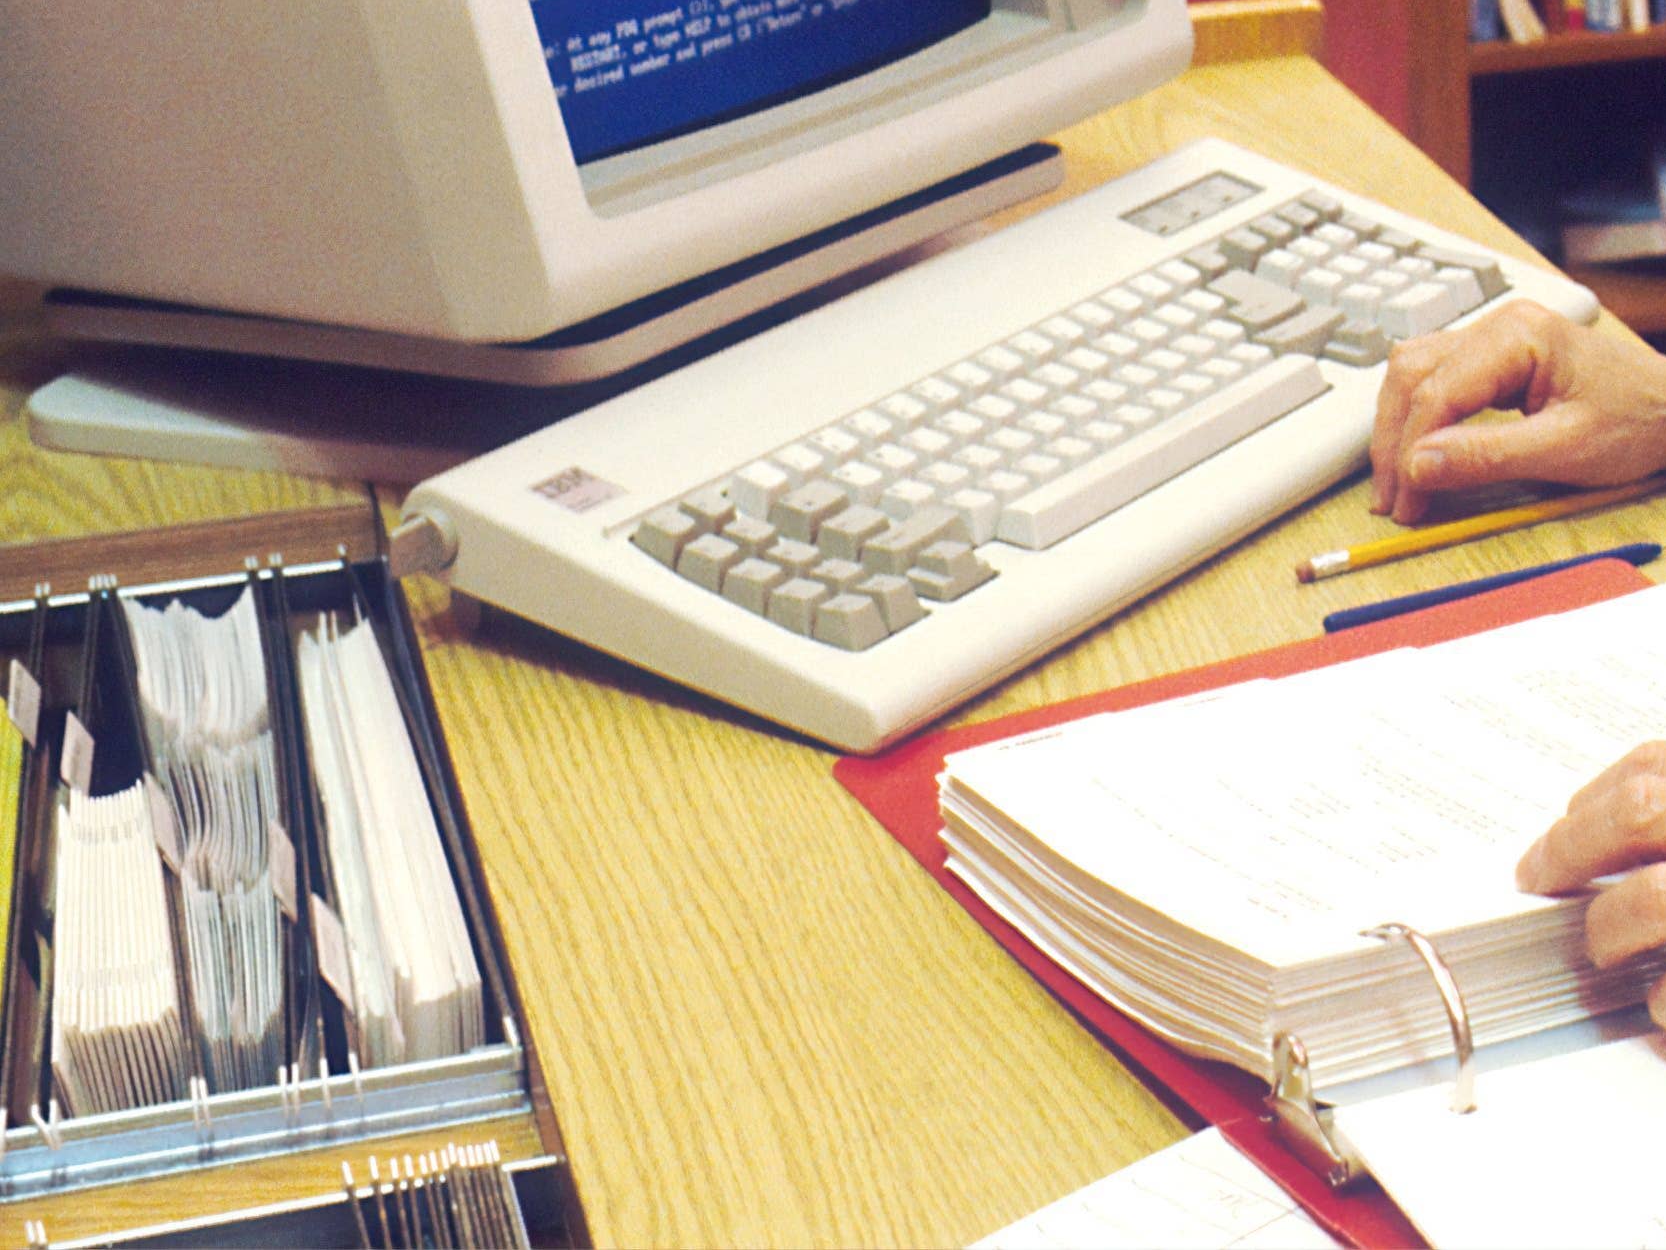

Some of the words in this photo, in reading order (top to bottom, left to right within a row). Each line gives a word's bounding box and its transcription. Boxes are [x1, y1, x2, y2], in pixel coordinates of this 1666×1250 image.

[643, 6, 683, 34] prompt
[574, 65, 624, 93] desired
[629, 53, 670, 76] number
[702, 34, 733, 56] press
